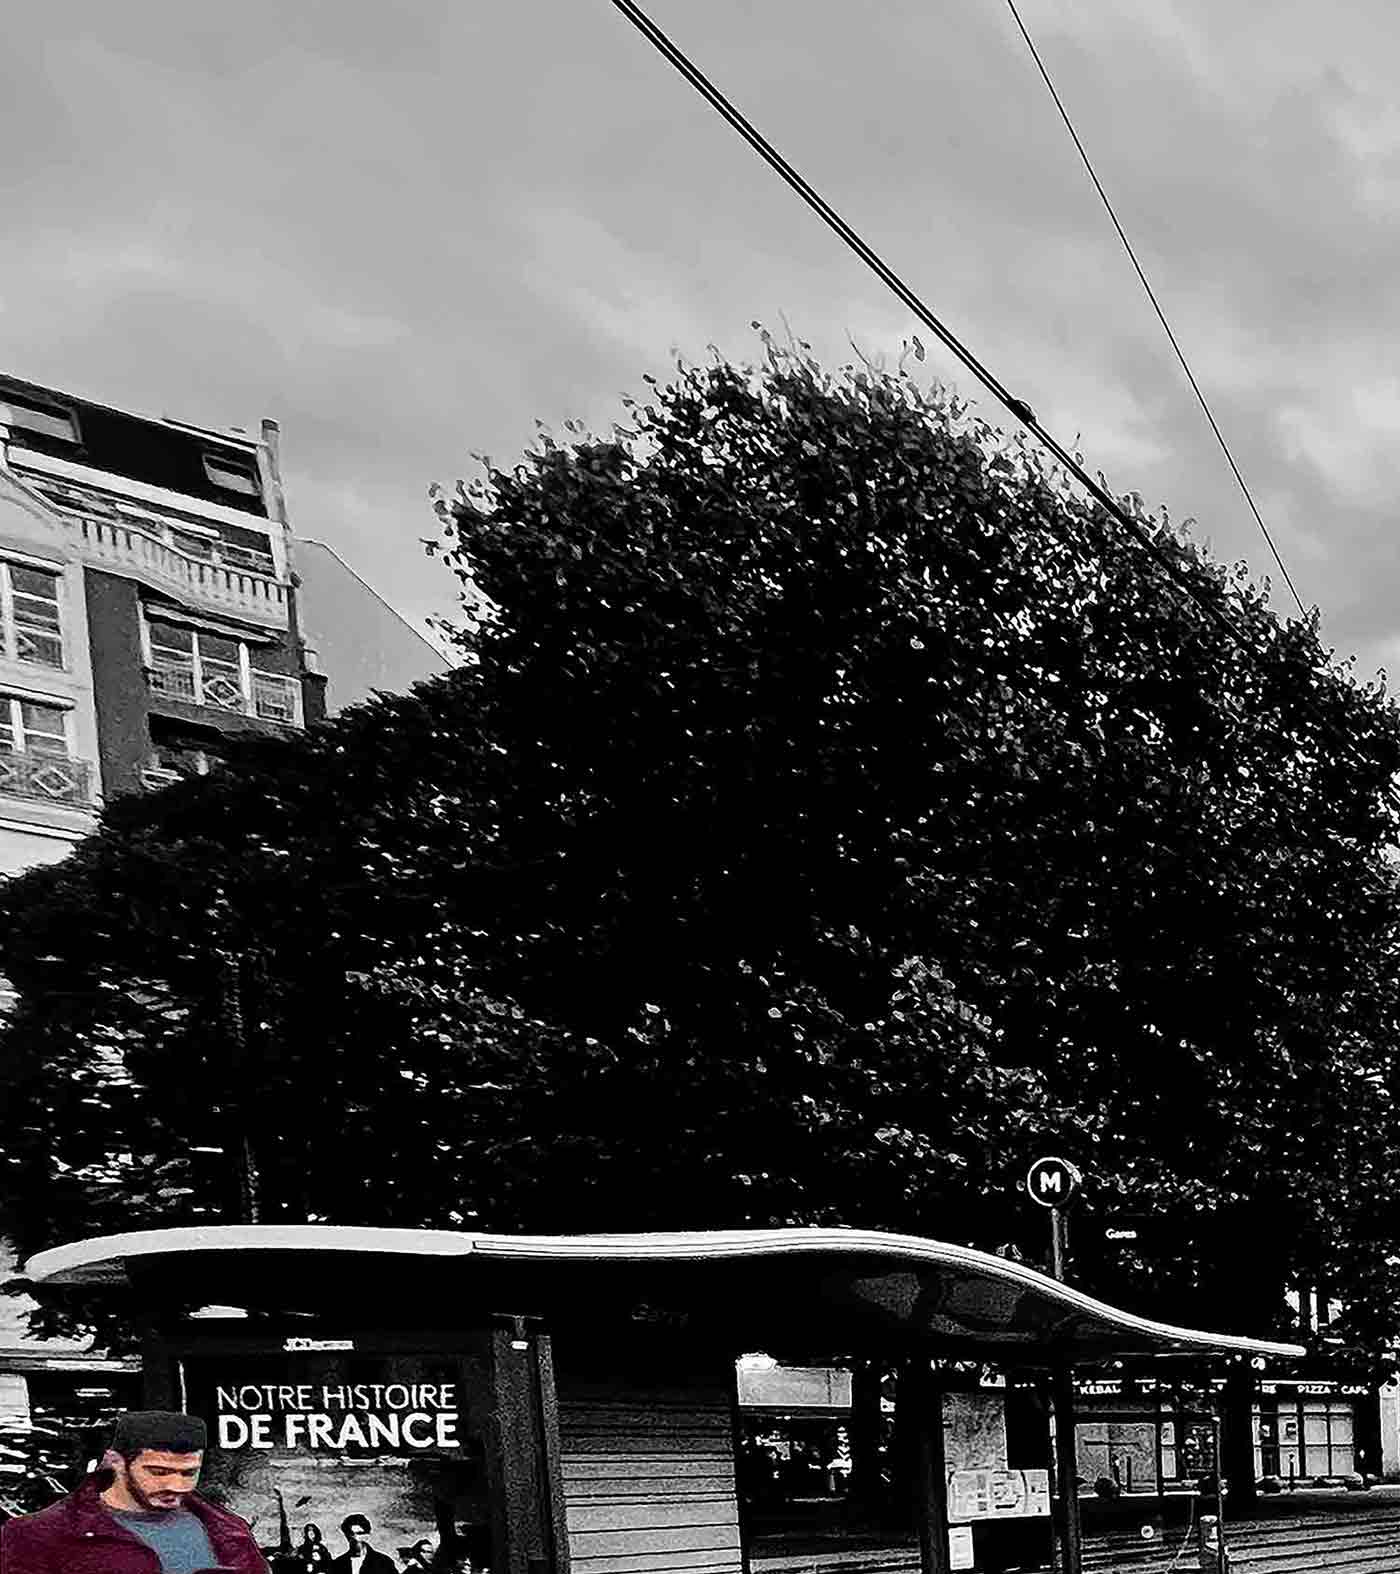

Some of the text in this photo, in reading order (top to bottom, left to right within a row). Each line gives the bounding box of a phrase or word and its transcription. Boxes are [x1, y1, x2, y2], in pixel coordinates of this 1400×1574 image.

[1040, 1171, 1061, 1193] M
[216, 1383, 457, 1410] NOTRE HISTOIRE
[1297, 1385, 1331, 1394] PIZZA
[217, 1412, 461, 1449] DE FRANCE
